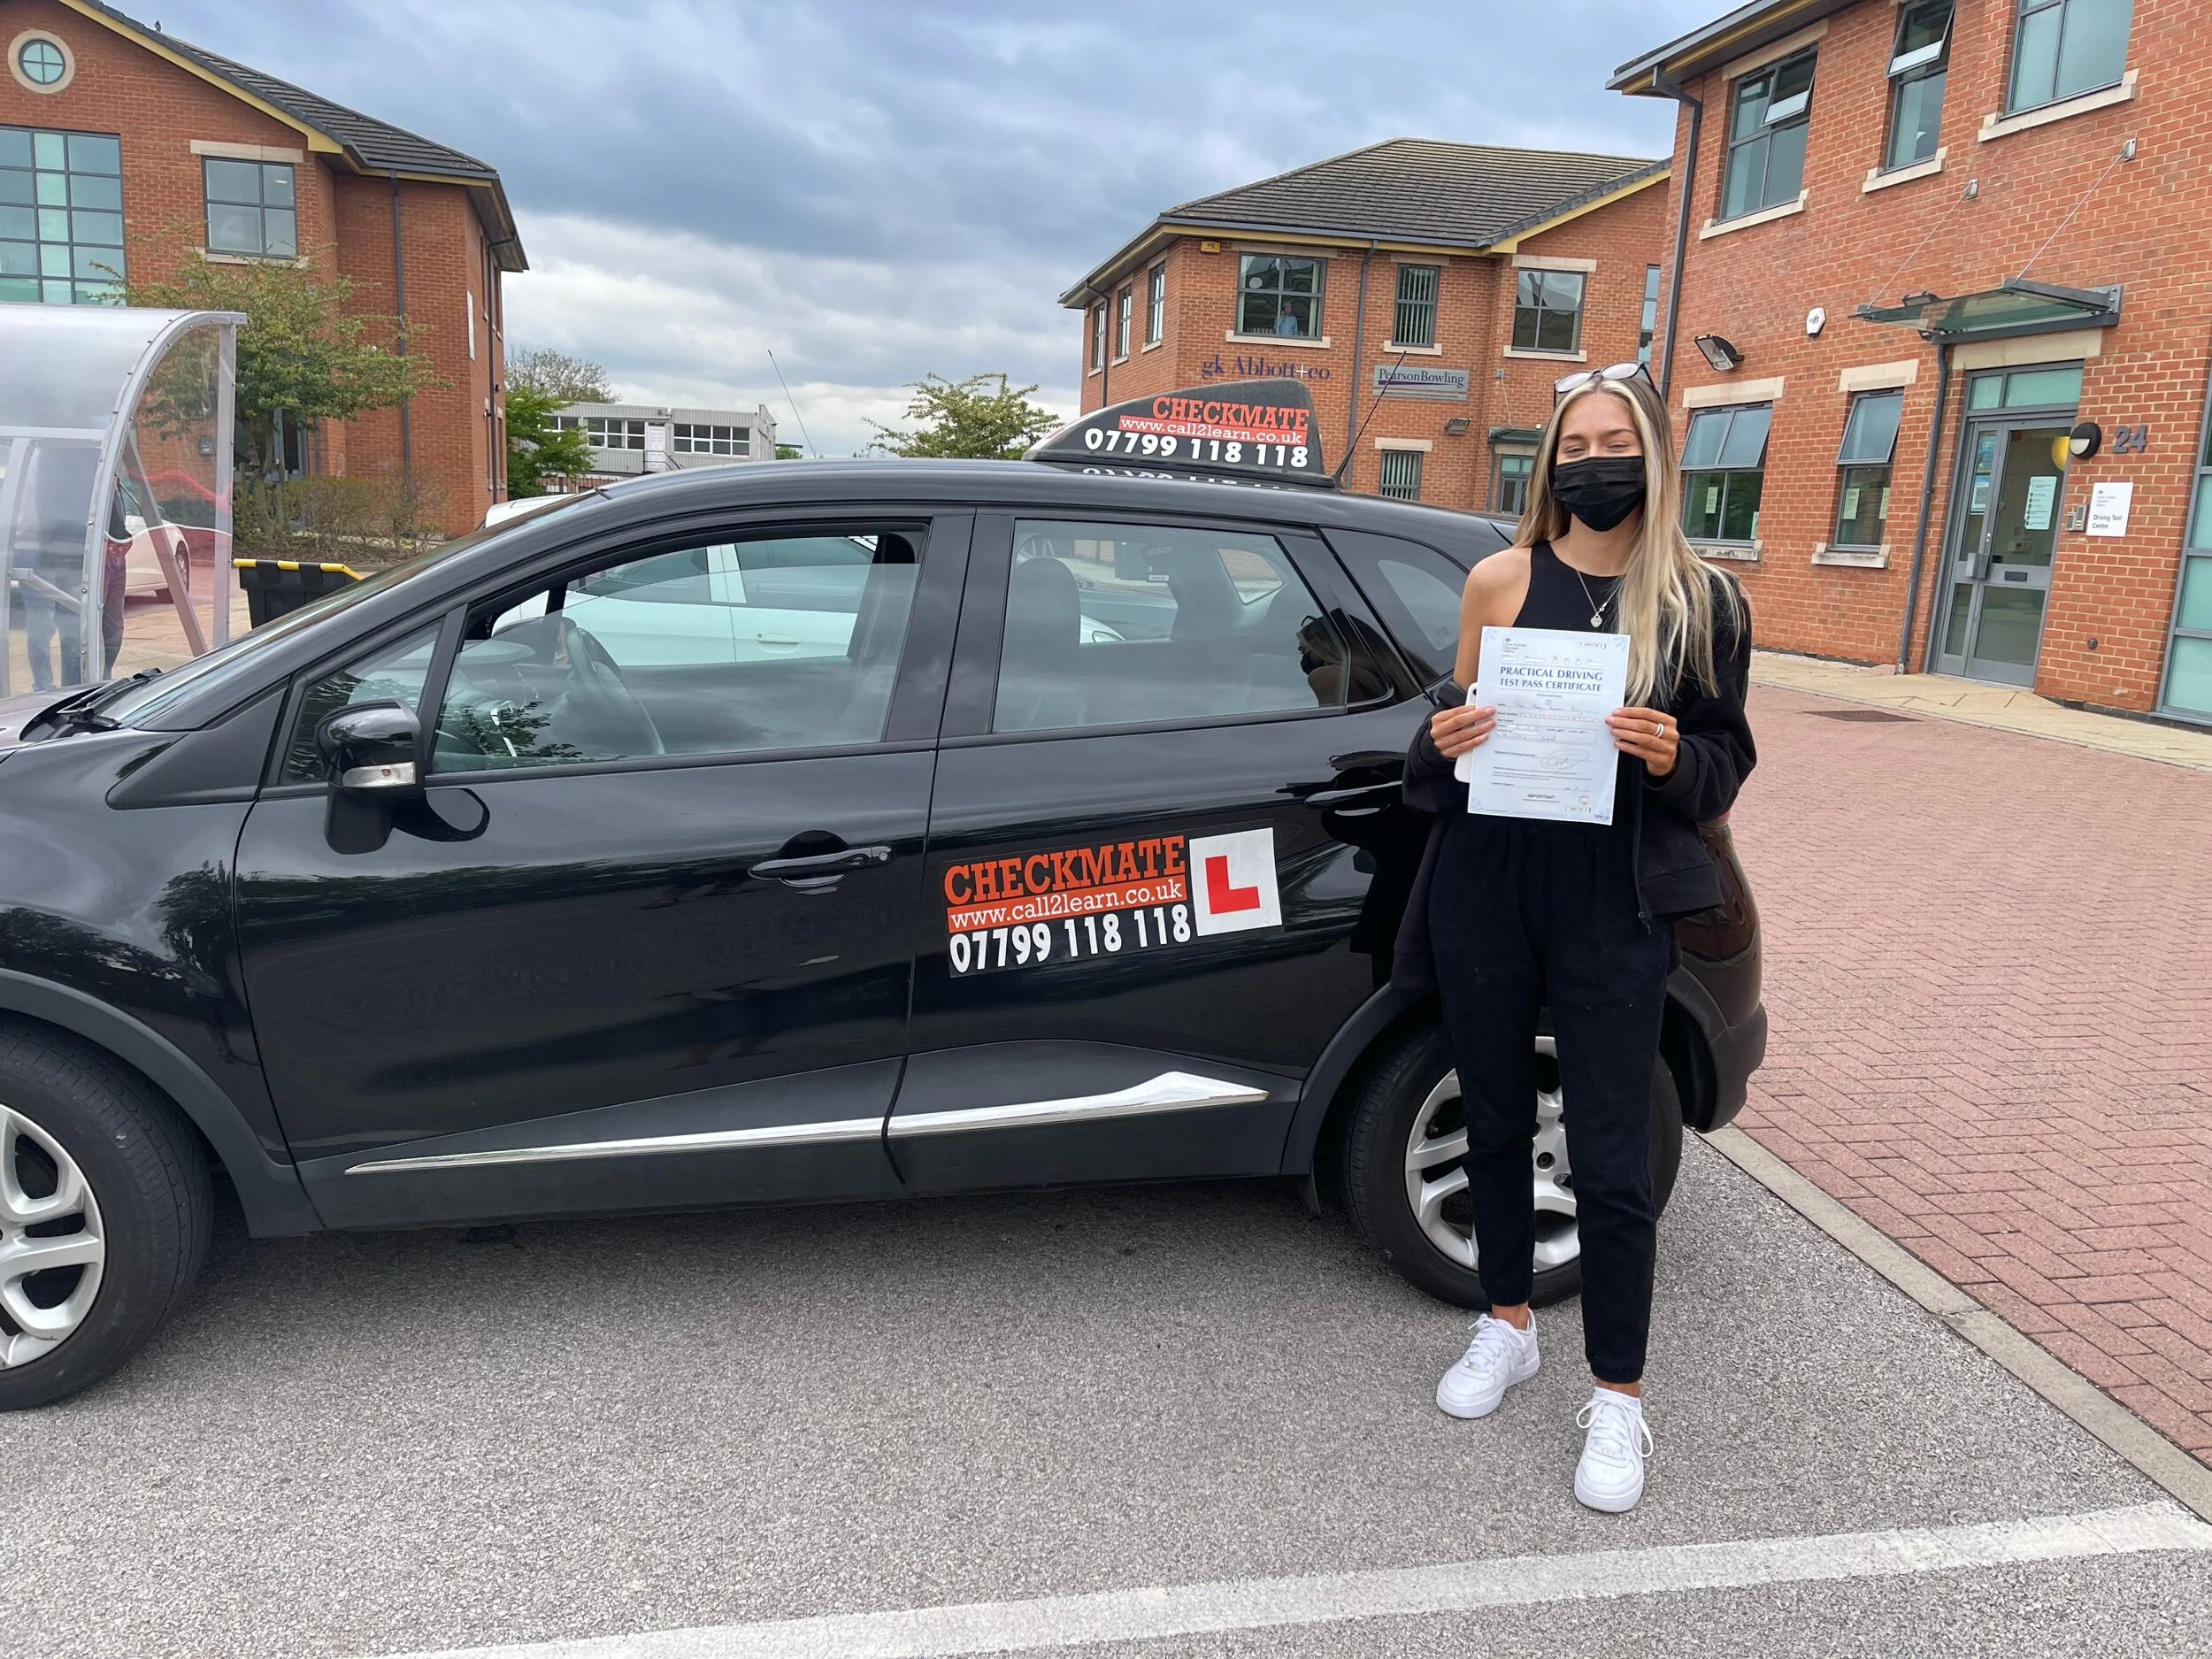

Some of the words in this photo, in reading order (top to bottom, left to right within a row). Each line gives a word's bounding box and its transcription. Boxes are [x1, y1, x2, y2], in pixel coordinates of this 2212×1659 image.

[1202, 354, 1225, 380] gk
[1379, 368, 1464, 388] PearsonBowling
[1152, 396, 1310, 431] CHECKMATE
[1119, 417, 1303, 445] www.call2learn.co.uk
[2112, 425, 2147, 454] 24
[1084, 428, 1178, 457] 07799
[1190, 439, 1241, 463] 118
[1256, 443, 1309, 468] 118
[1500, 666, 1555, 678] PRACTICAL
[1557, 669, 1603, 681] DRIVING
[1500, 678, 1519, 687] TEST
[1522, 680, 1543, 688] PASS
[1545, 680, 1602, 692] CERTIFICATE
[943, 834, 1186, 905] CHECKMATE
[1205, 855, 1261, 915] L
[950, 879, 1183, 929] www.call2learn.co.uk
[949, 923, 1051, 973] 07799
[1064, 913, 1122, 957] 118
[1133, 903, 1191, 948] 118
